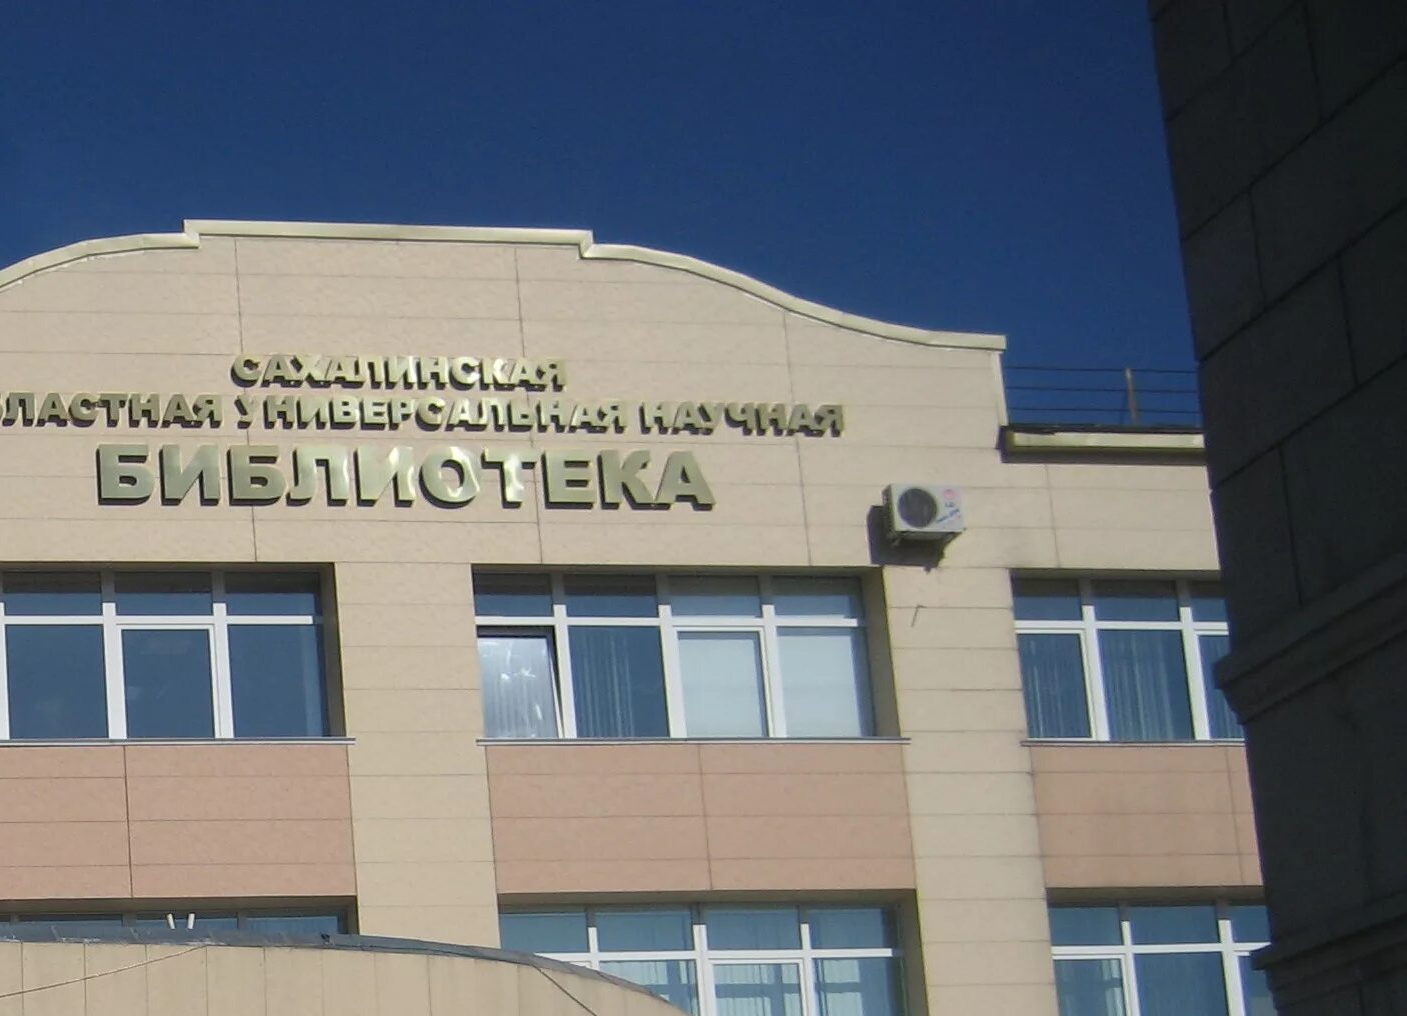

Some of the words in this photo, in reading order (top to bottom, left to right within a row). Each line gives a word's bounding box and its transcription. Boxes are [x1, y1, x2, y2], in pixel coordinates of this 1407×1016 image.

[231, 354, 566, 391] САХАЛИНСКАЯ
[234, 394, 627, 434] УНИВЕРСАЛЬНАЯ
[639, 401, 845, 437] НАУЧНАЯ
[95, 443, 716, 511] БИБЛИОТЕКА
